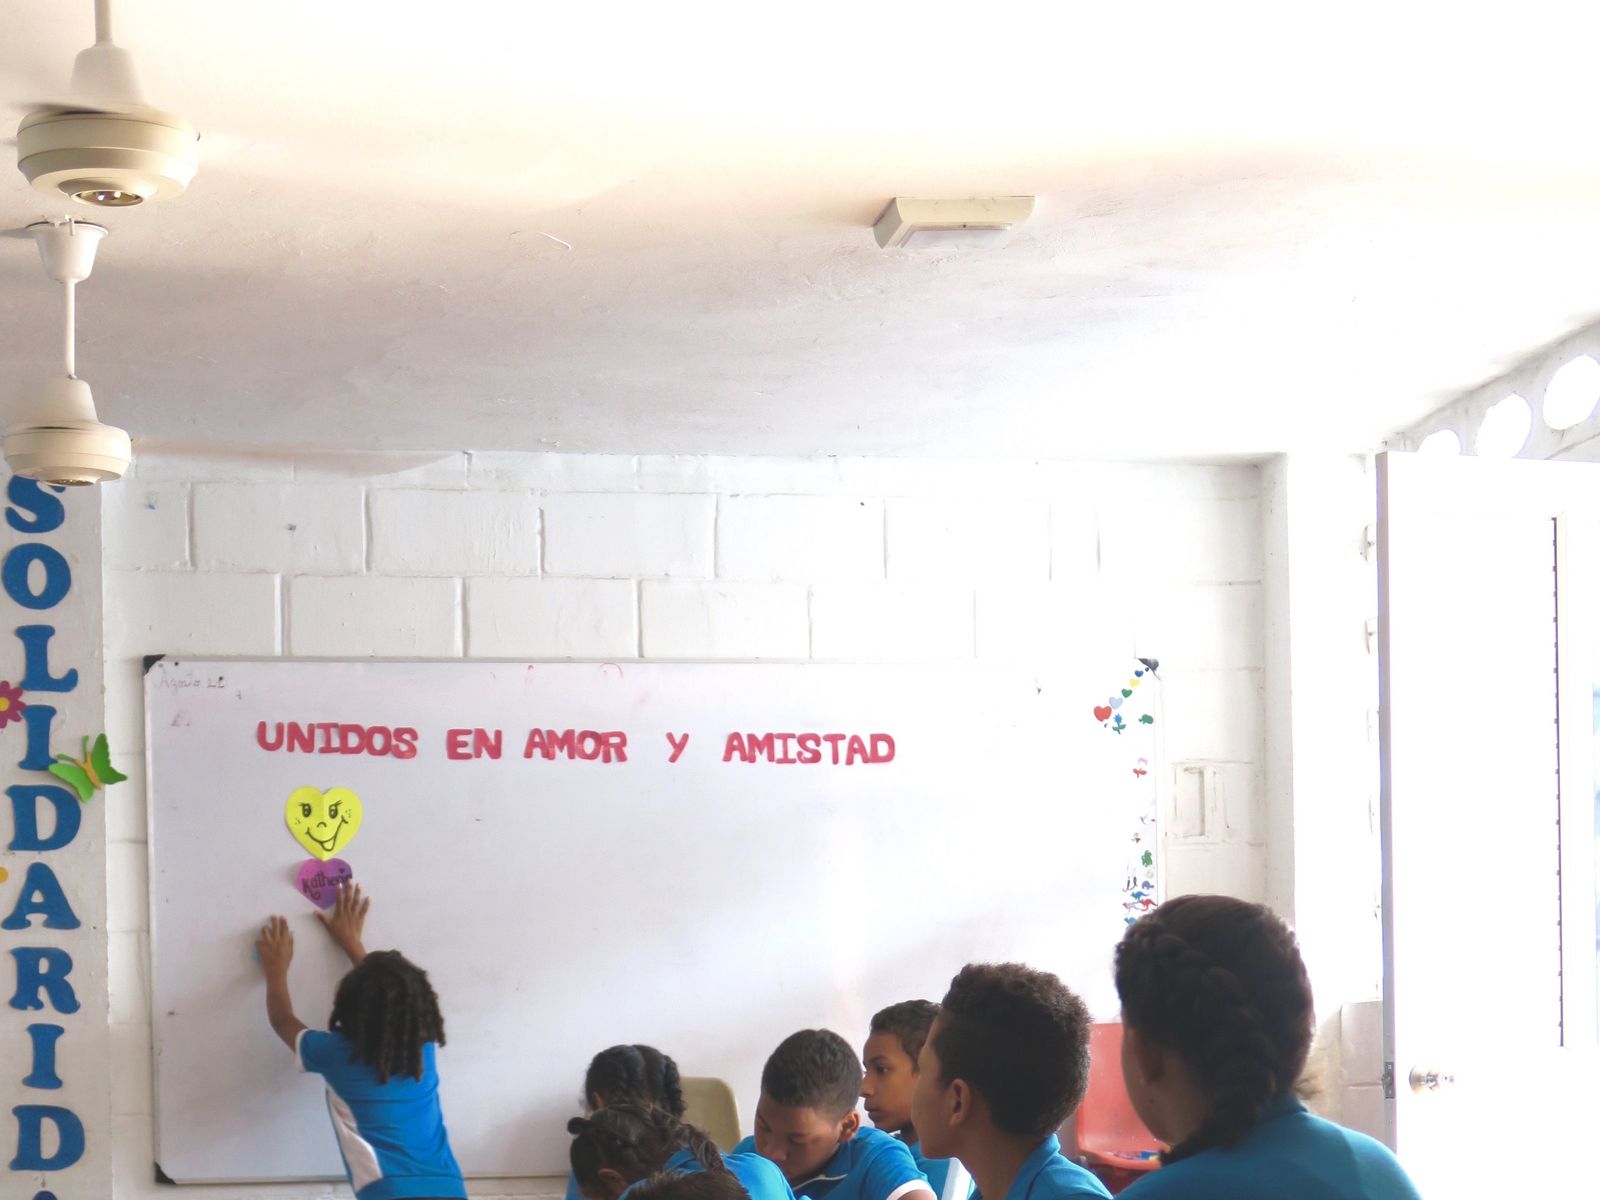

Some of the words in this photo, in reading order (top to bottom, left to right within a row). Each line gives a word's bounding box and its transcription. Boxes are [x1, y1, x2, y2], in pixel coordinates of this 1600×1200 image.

[256, 720, 419, 760] UNIDOS
[446, 728, 503, 761] EN
[523, 727, 628, 763] AMOR
[666, 732, 689, 763] Y
[723, 731, 896, 766] AMISTAD
